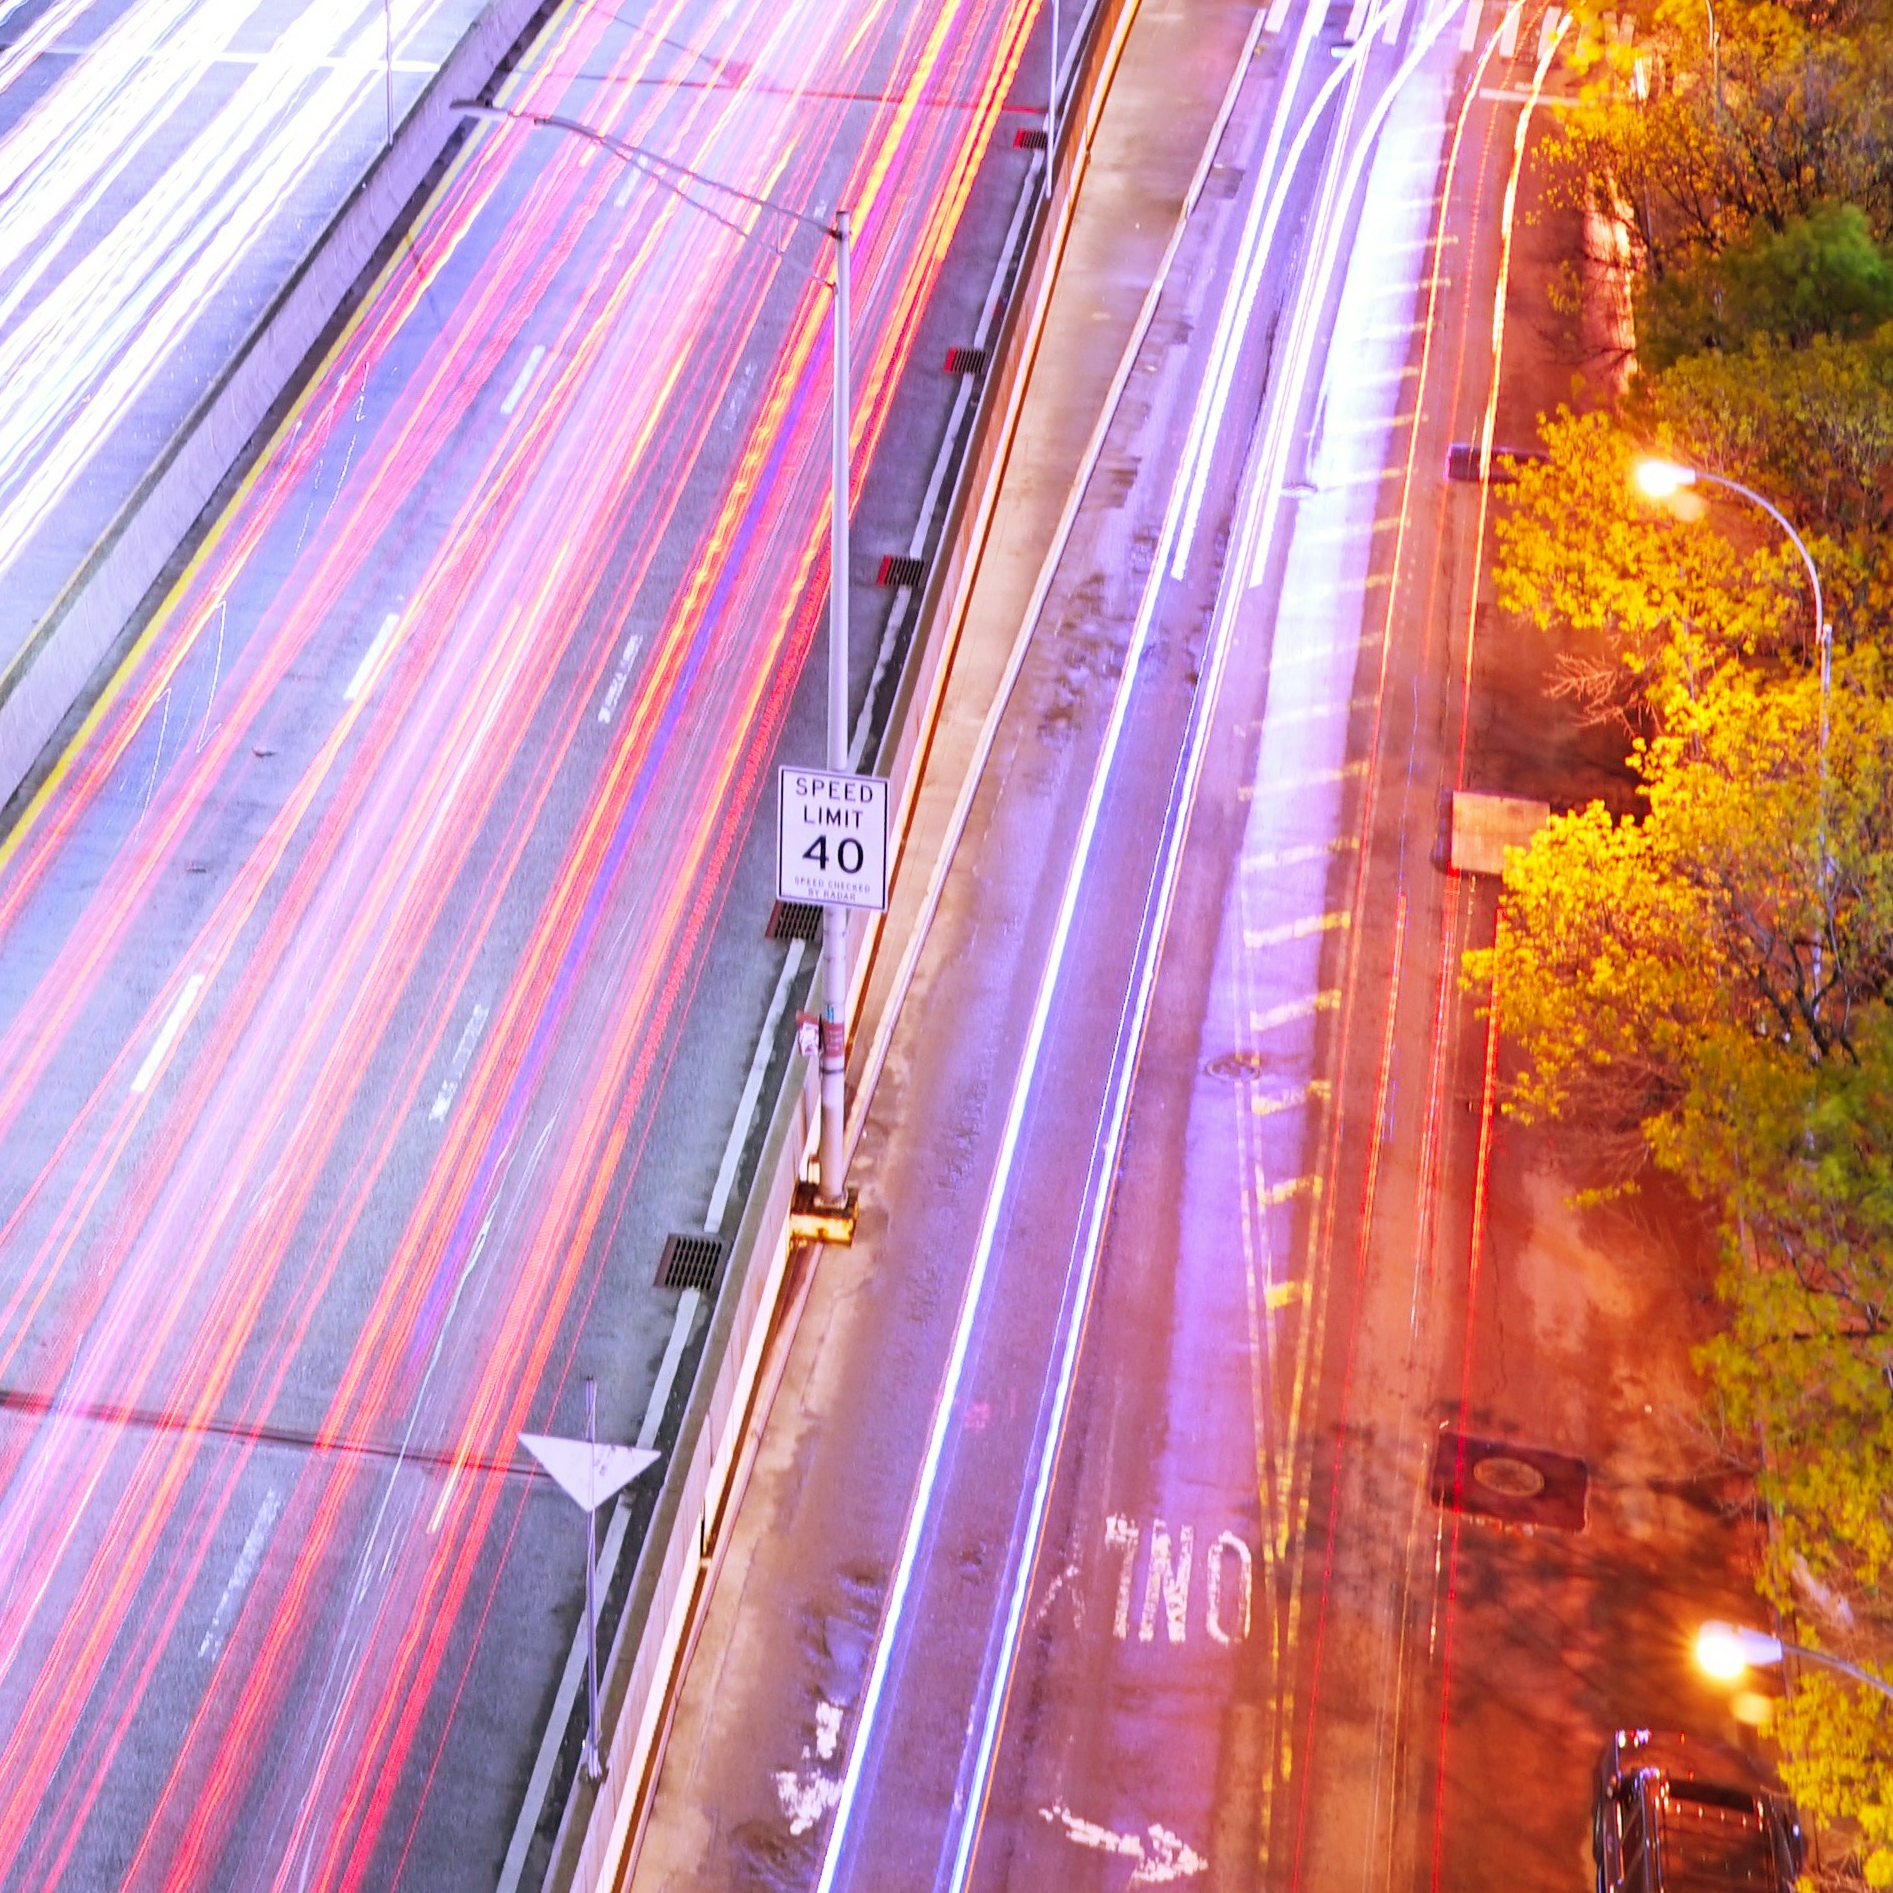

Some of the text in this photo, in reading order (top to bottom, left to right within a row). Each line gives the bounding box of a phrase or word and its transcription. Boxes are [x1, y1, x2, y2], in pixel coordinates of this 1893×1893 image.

[796, 777, 873, 803] SPEED
[804, 805, 864, 829] LIMIT
[802, 833, 865, 874] 40
[795, 876, 871, 893] SPEED CHECKED
[808, 888, 856, 901] BY RADAR
